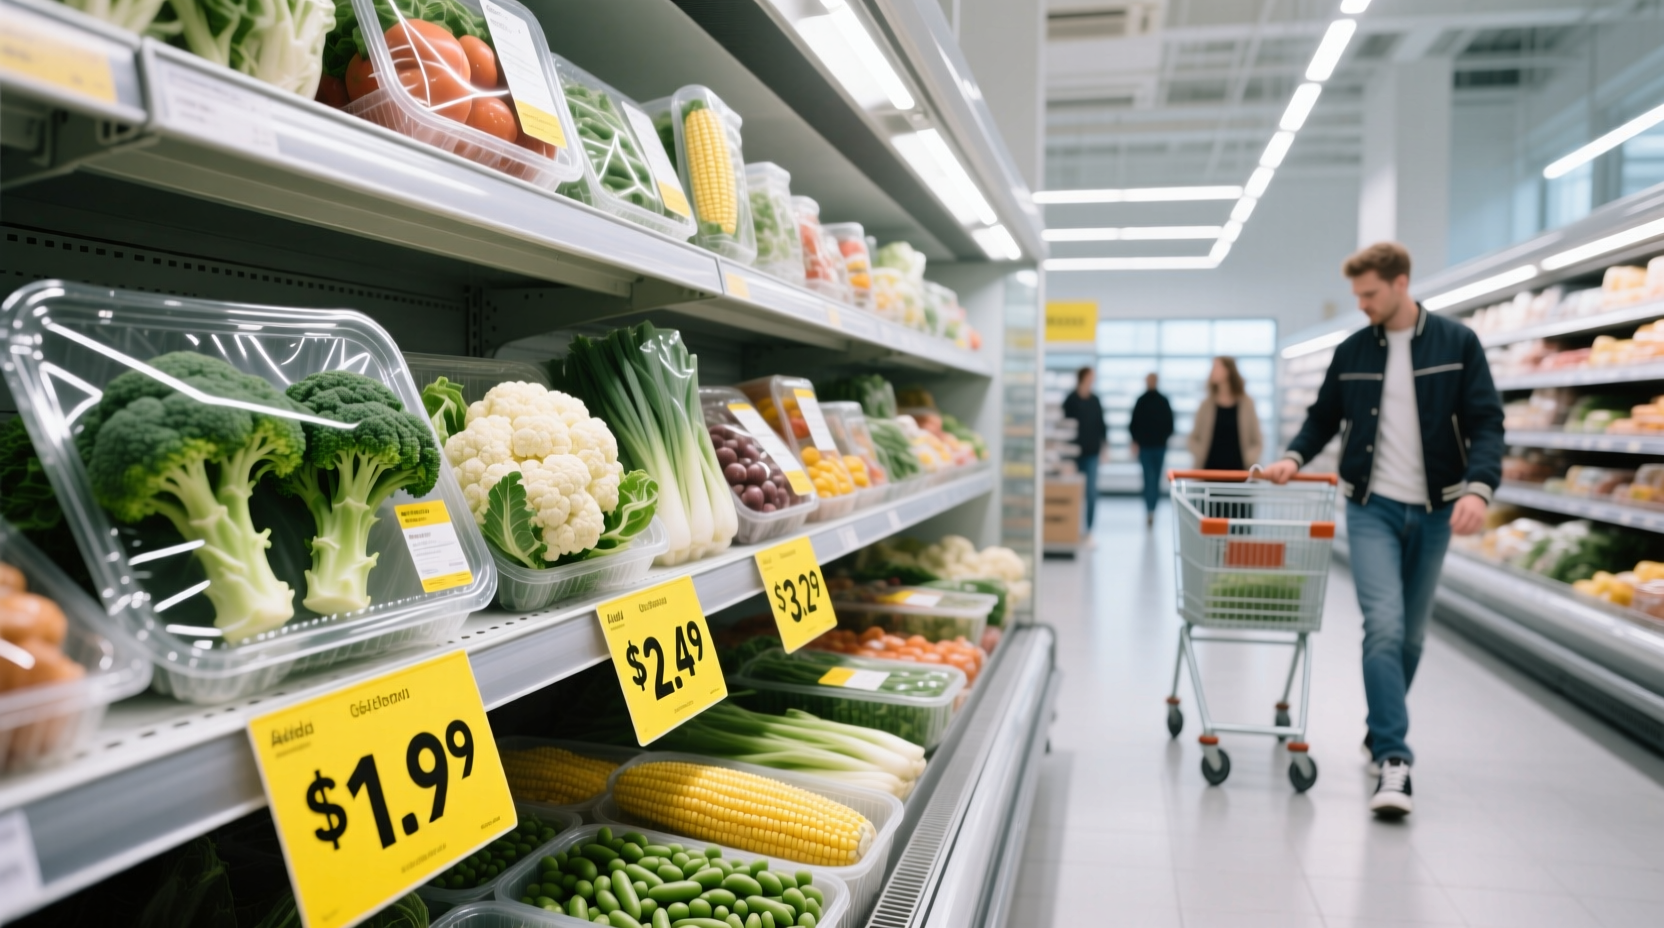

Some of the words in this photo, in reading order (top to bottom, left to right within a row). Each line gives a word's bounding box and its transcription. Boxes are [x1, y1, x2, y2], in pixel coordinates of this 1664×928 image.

[774, 570, 820, 623] $3.29
[626, 620, 703, 701] $2.49
[305, 719, 475, 850] $1.99
